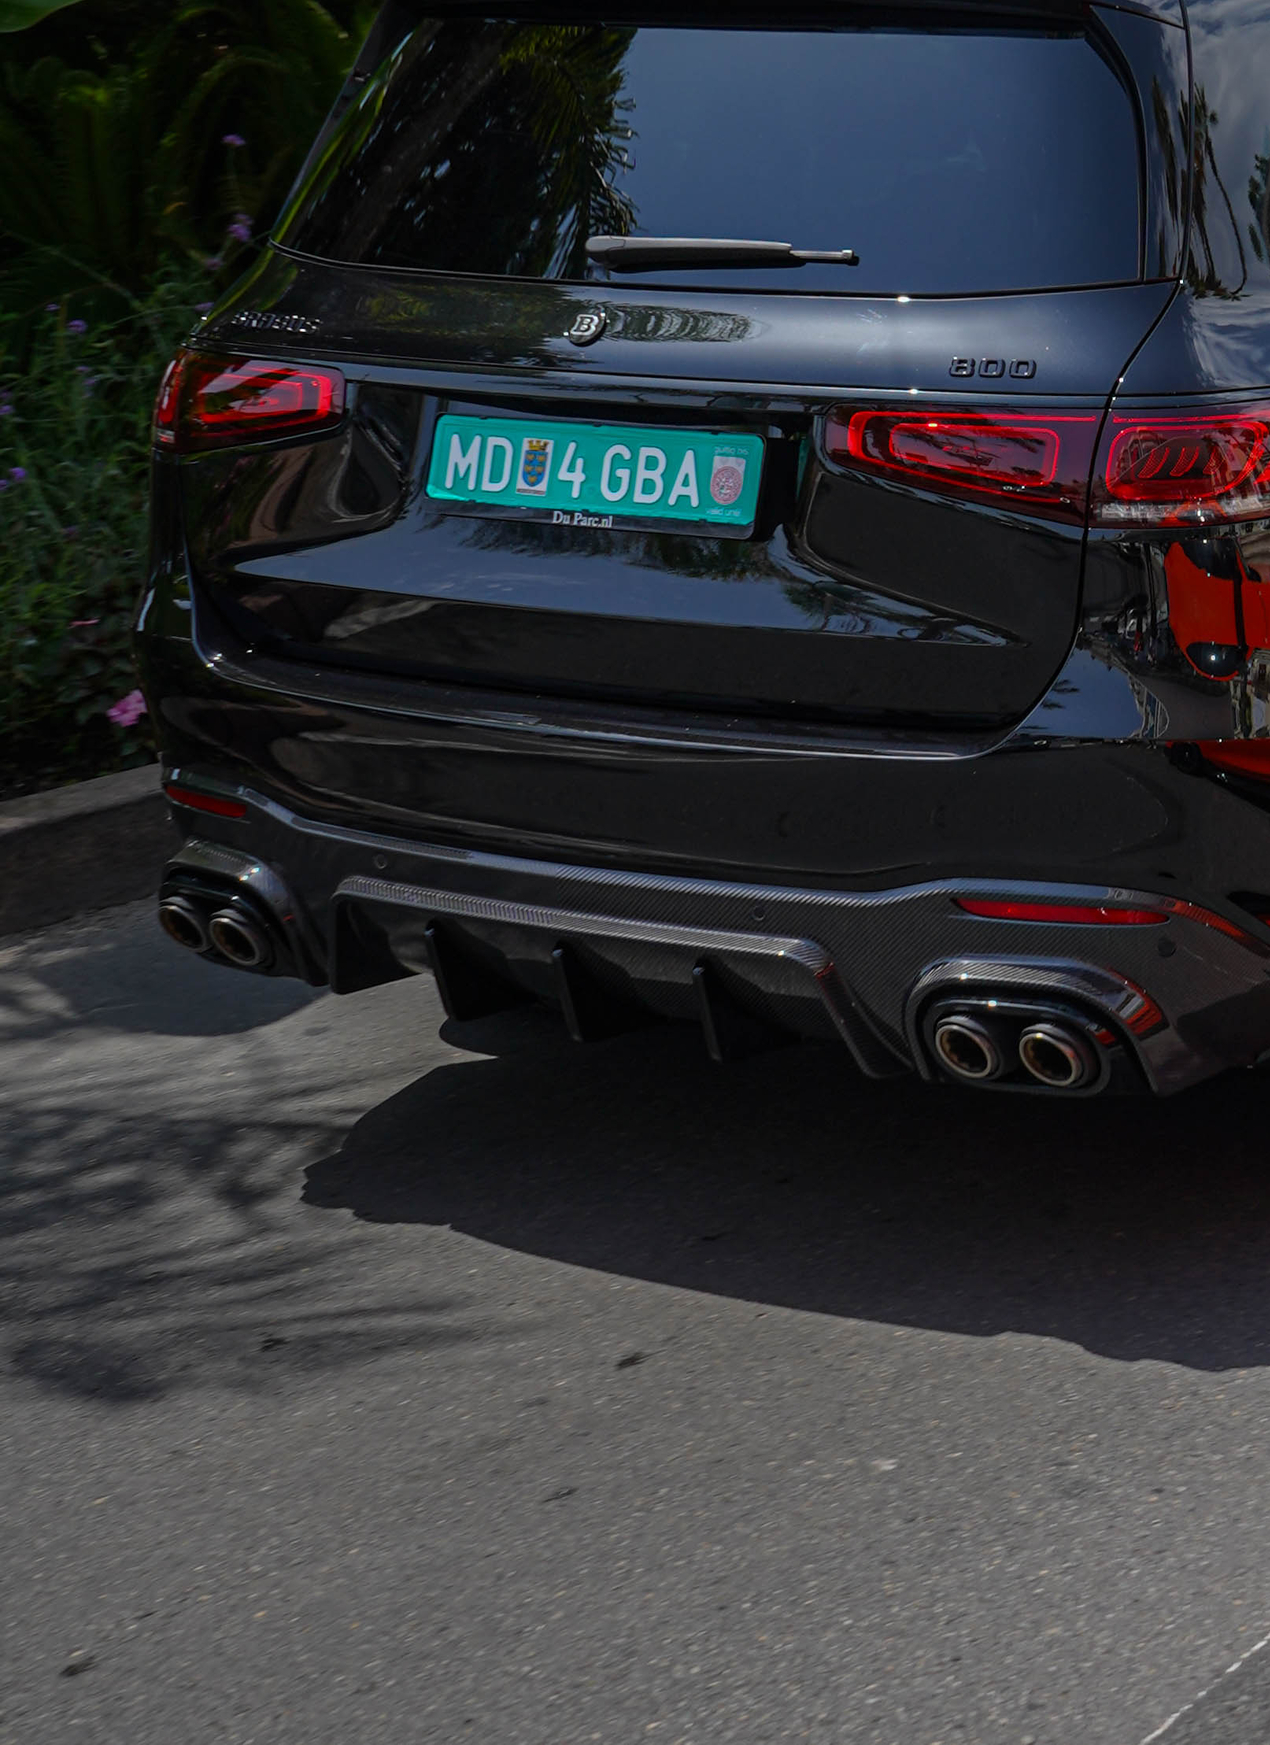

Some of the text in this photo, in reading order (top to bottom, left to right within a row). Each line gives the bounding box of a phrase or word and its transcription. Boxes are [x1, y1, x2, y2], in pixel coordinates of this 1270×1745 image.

[949, 356, 1037, 379] 800
[444, 432, 700, 508] MD 4 GBA
[551, 510, 614, 529] Du Parc.nl
